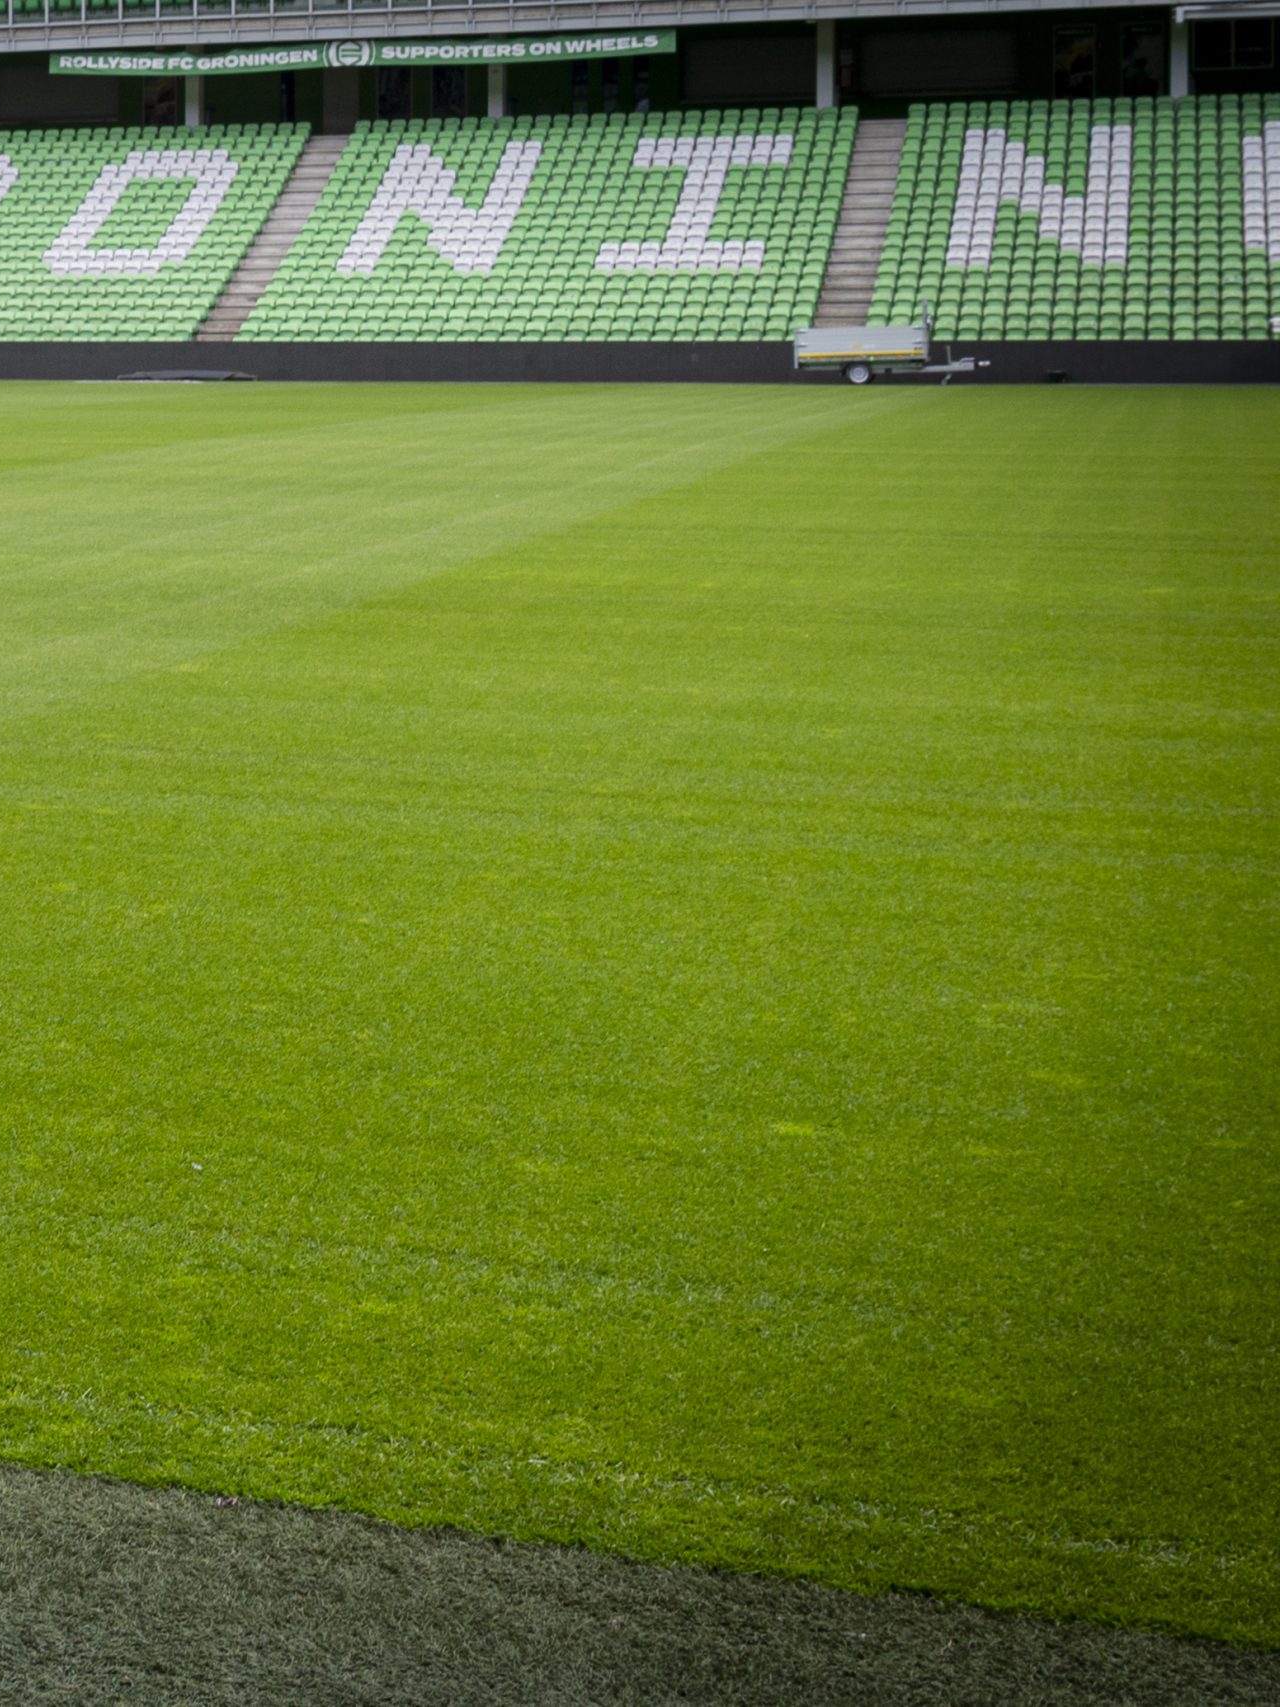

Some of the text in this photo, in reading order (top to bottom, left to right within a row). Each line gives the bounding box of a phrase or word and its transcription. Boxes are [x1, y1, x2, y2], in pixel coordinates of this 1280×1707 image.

[59, 34, 659, 70] ROLLYSIDE FC GRONINGEN SUPPORTERS ON WHEELS
